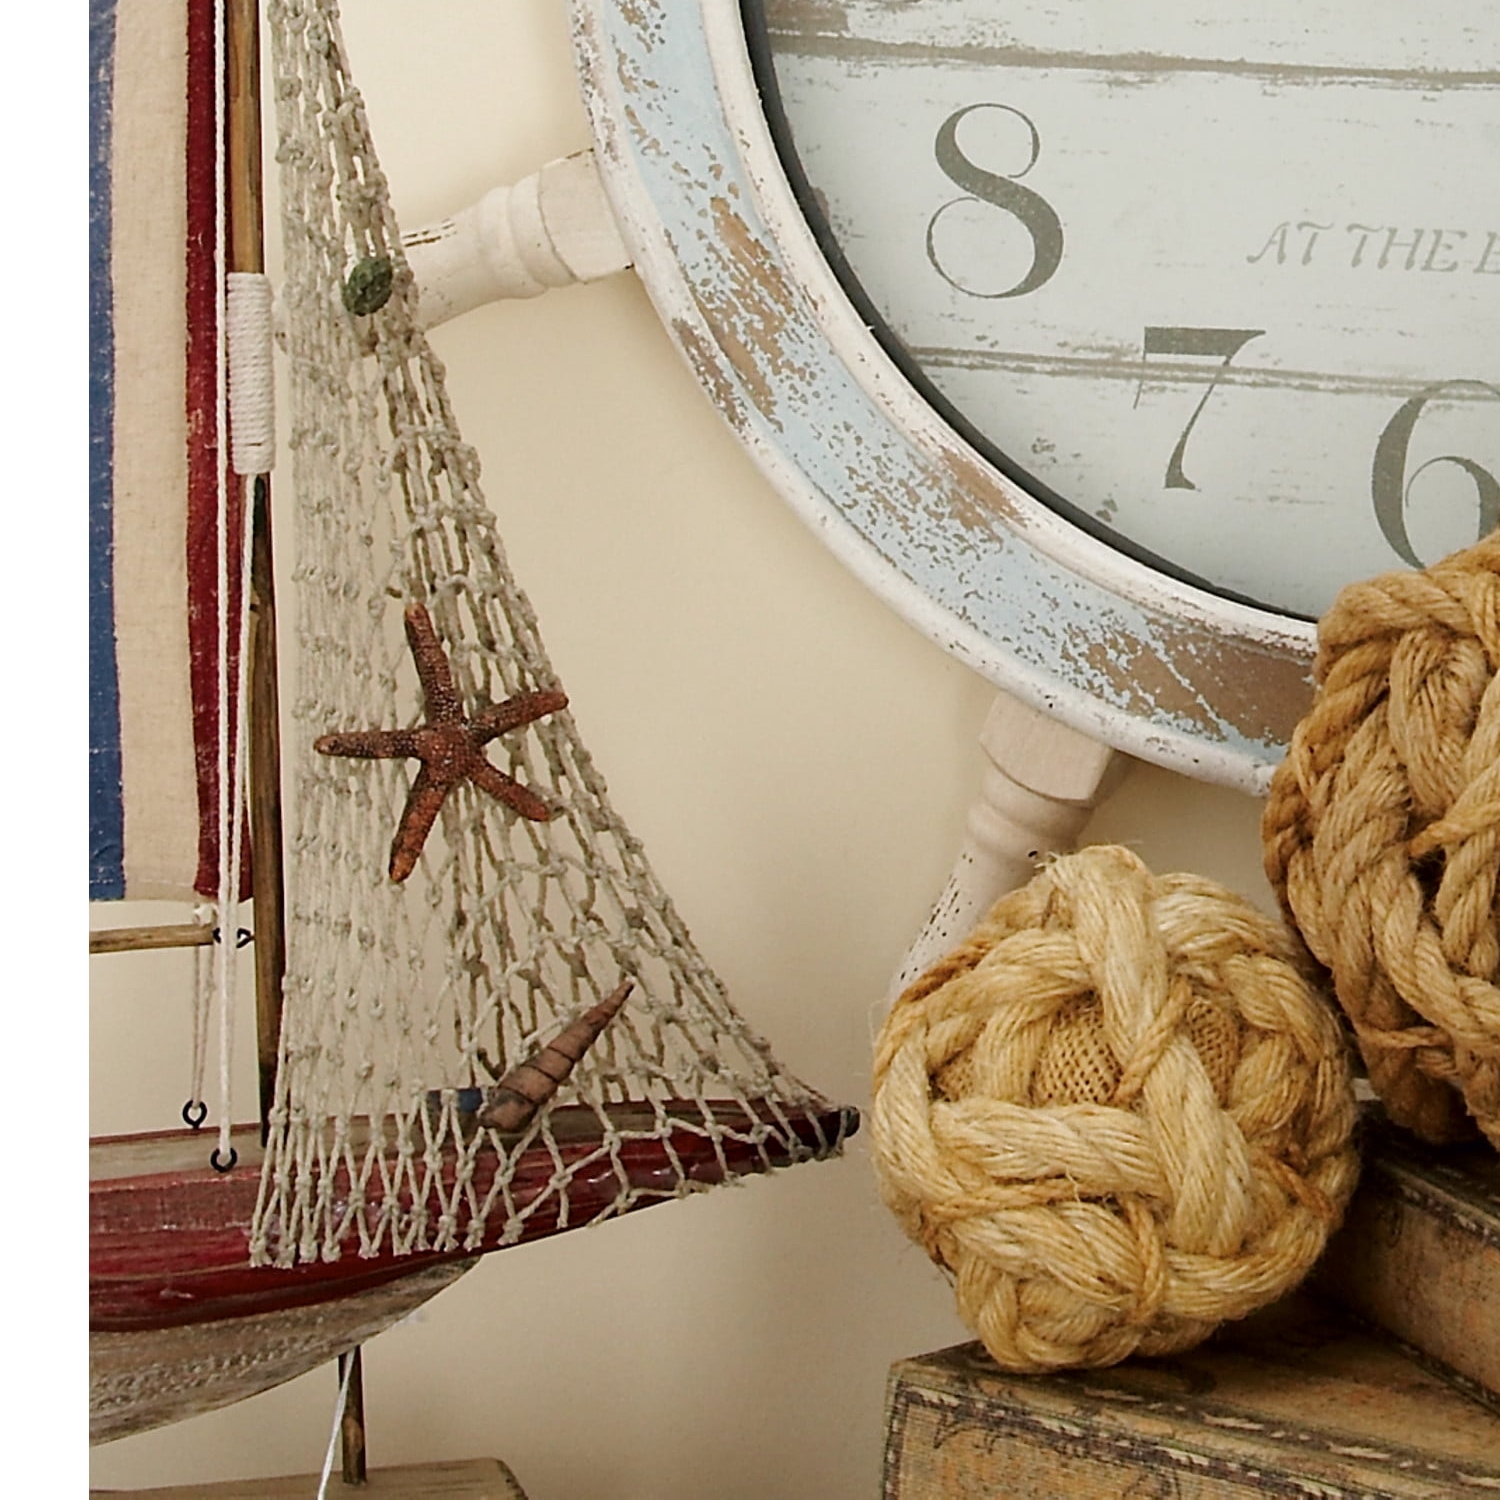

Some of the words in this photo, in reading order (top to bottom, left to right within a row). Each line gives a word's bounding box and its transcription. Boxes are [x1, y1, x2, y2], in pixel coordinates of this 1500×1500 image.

[926, 102, 1064, 299] 8
[1246, 221, 1334, 266] AT
[1347, 224, 1467, 273] THE
[1133, 325, 1266, 491] 7
